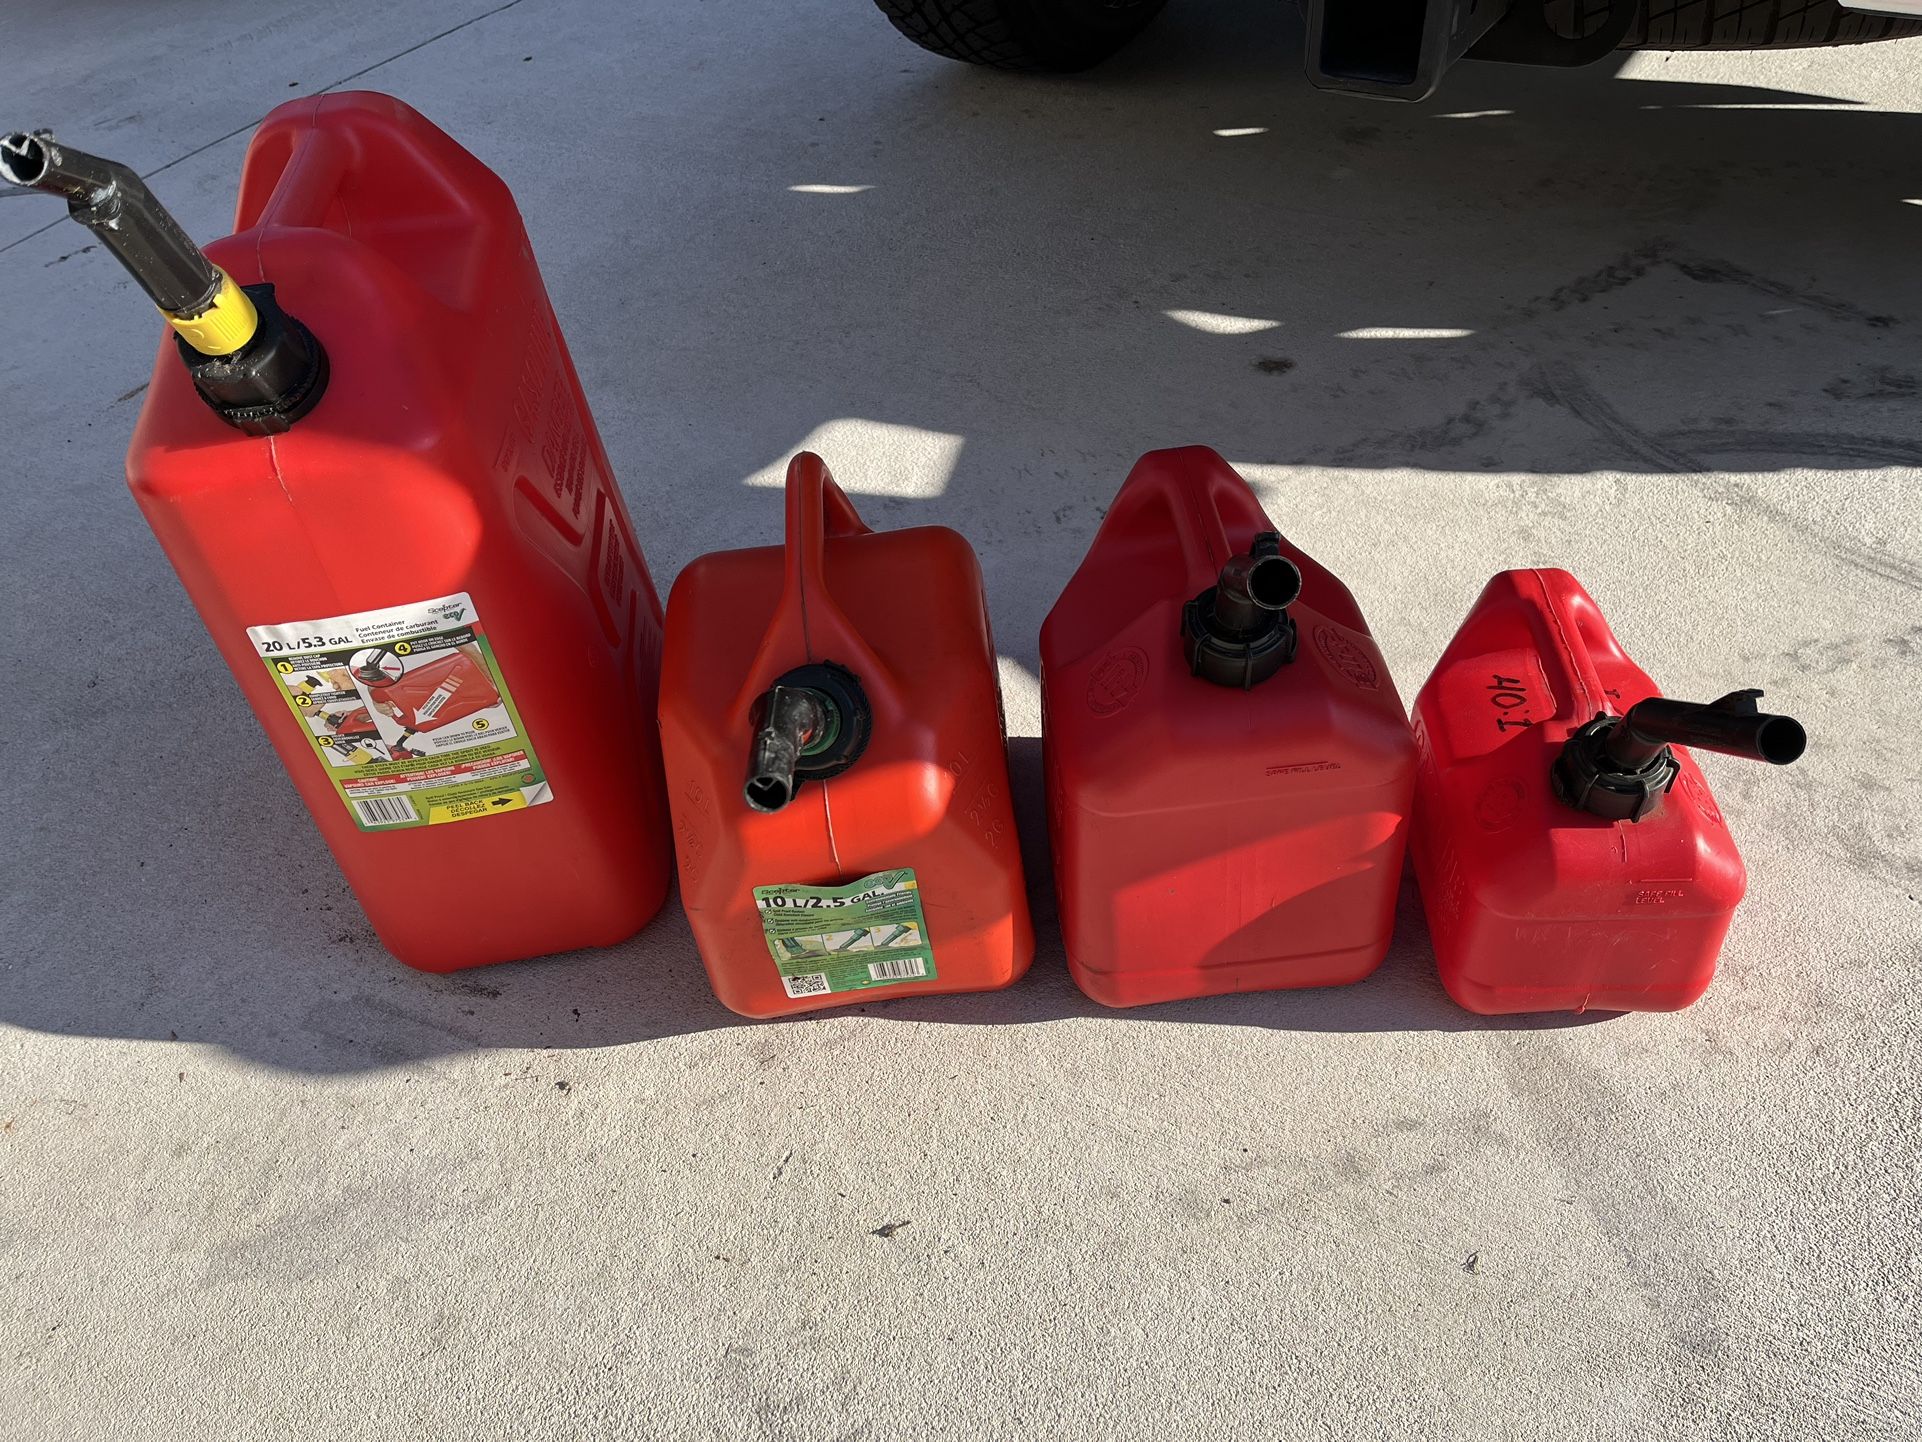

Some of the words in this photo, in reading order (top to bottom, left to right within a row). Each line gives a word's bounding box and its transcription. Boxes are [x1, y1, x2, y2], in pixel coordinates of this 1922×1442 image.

[428, 602, 462, 614] Scepter
[358, 628, 393, 638] Conteneur
[405, 620, 438, 630] carburant
[372, 620, 405, 630] Container
[361, 635, 386, 644] Envase
[397, 626, 437, 638] combustible
[261, 640, 283, 652] 20
[329, 636, 352, 645] GAL
[399, 643, 407, 653] 4
[281, 663, 288, 671] 1
[299, 697, 309, 705] 2
[476, 720, 485, 728] 5
[321, 737, 330, 745] 3
[447, 802, 463, 810] PEEL
[452, 808, 487, 817] DESPEGAR
[761, 896, 787, 908] 10
[851, 890, 884, 903] GAL.
